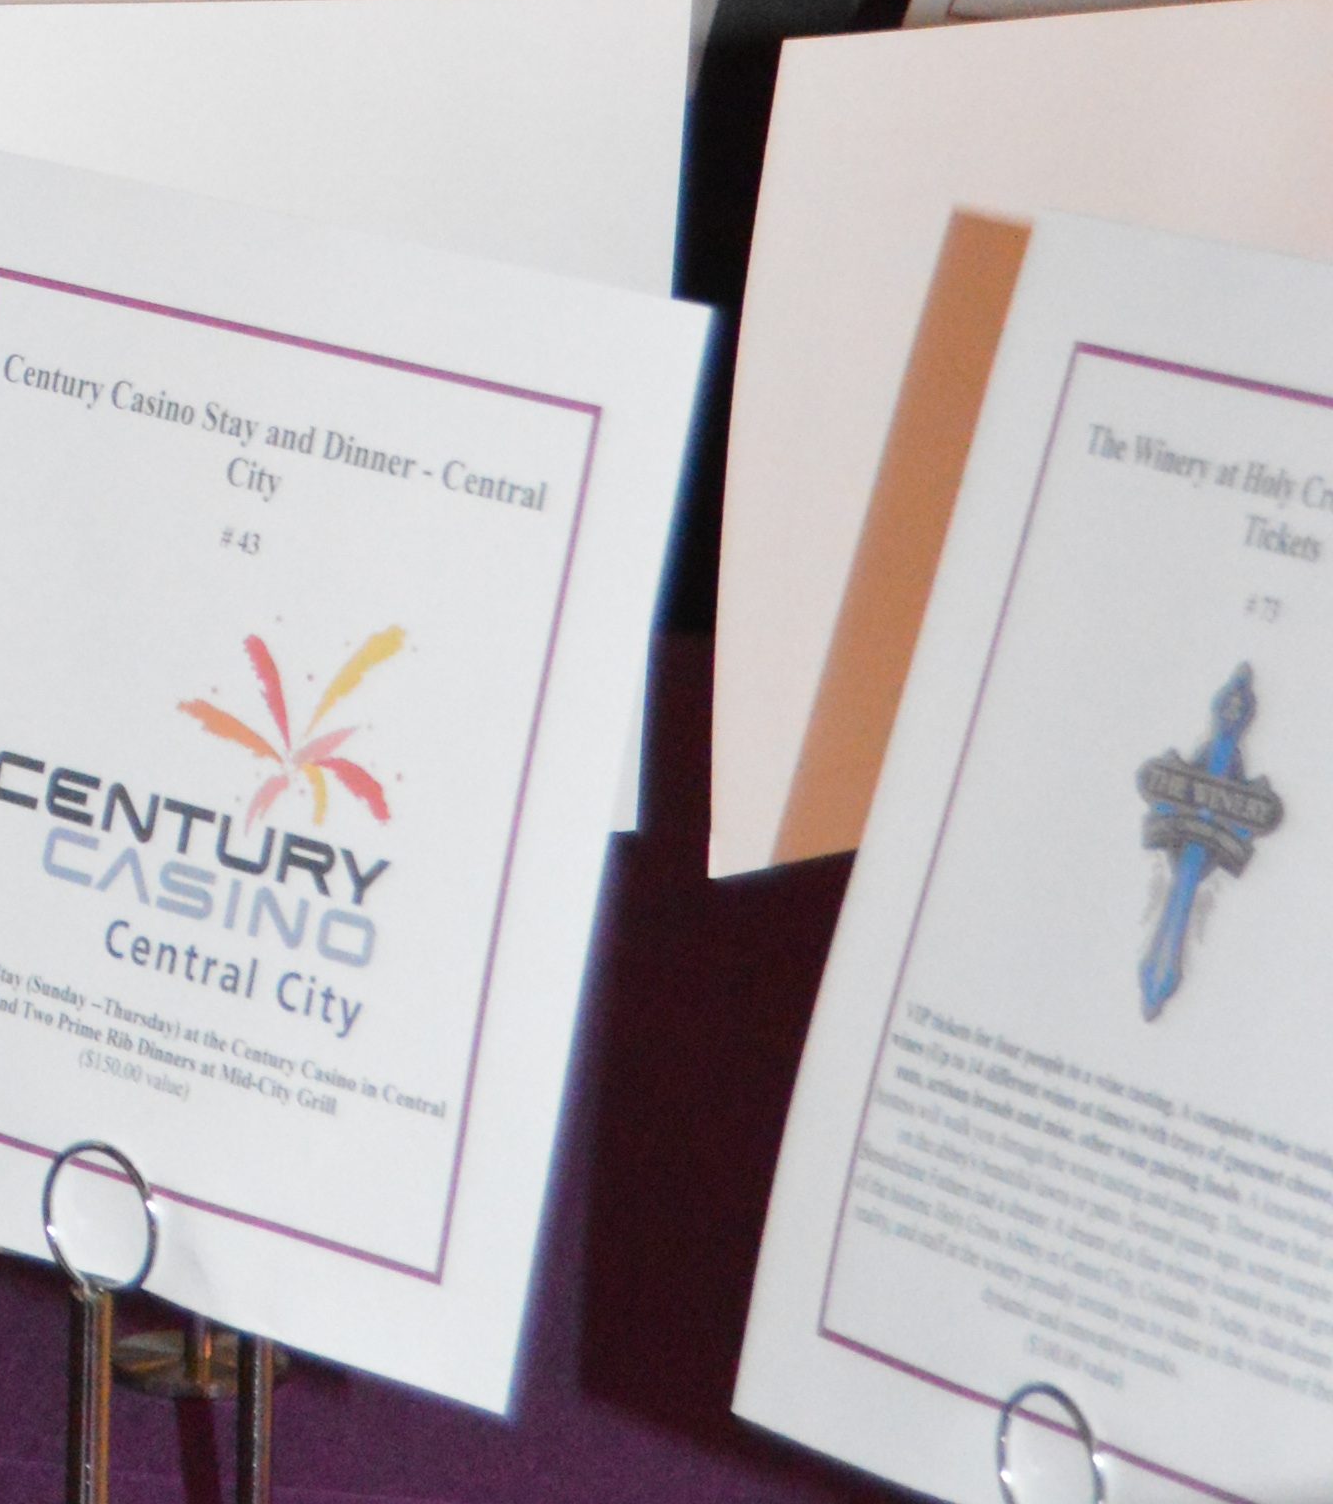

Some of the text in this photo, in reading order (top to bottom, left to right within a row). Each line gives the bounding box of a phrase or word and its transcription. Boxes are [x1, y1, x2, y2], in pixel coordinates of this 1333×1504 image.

[3, 353, 105, 410] Century
[111, 380, 195, 426] Casino
[201, 401, 260, 448] Stay
[265, 425, 316, 456] and
[322, 429, 418, 480] Dinner
[442, 459, 549, 512] Central
[1088, 423, 1128, 462] The
[1134, 434, 1211, 489] Winery
[226, 457, 283, 503] City
[236, 531, 262, 556] 43
[1243, 513, 1322, 563] Tickets
[42, 826, 377, 968] CASINO
[104, 919, 365, 1039] Central City
[23, 1001, 53, 1026] Two
[56, 1012, 102, 1043] Prime
[105, 1027, 133, 1052] Rib
[136, 1037, 196, 1072] Dinners
[199, 1055, 216, 1078] at
[220, 1062, 293, 1105] Mid-City
[296, 1087, 338, 1116] Grill
[26, 974, 87, 1012] (Sunday
[184, 1026, 200, 1046] at
[202, 1029, 229, 1054] the
[231, 1036, 298, 1078] Century
[301, 1059, 357, 1093] Casino
[360, 1077, 378, 1099] in
[382, 1083, 448, 1120] Central
[145, 1072, 191, 1102] value)
